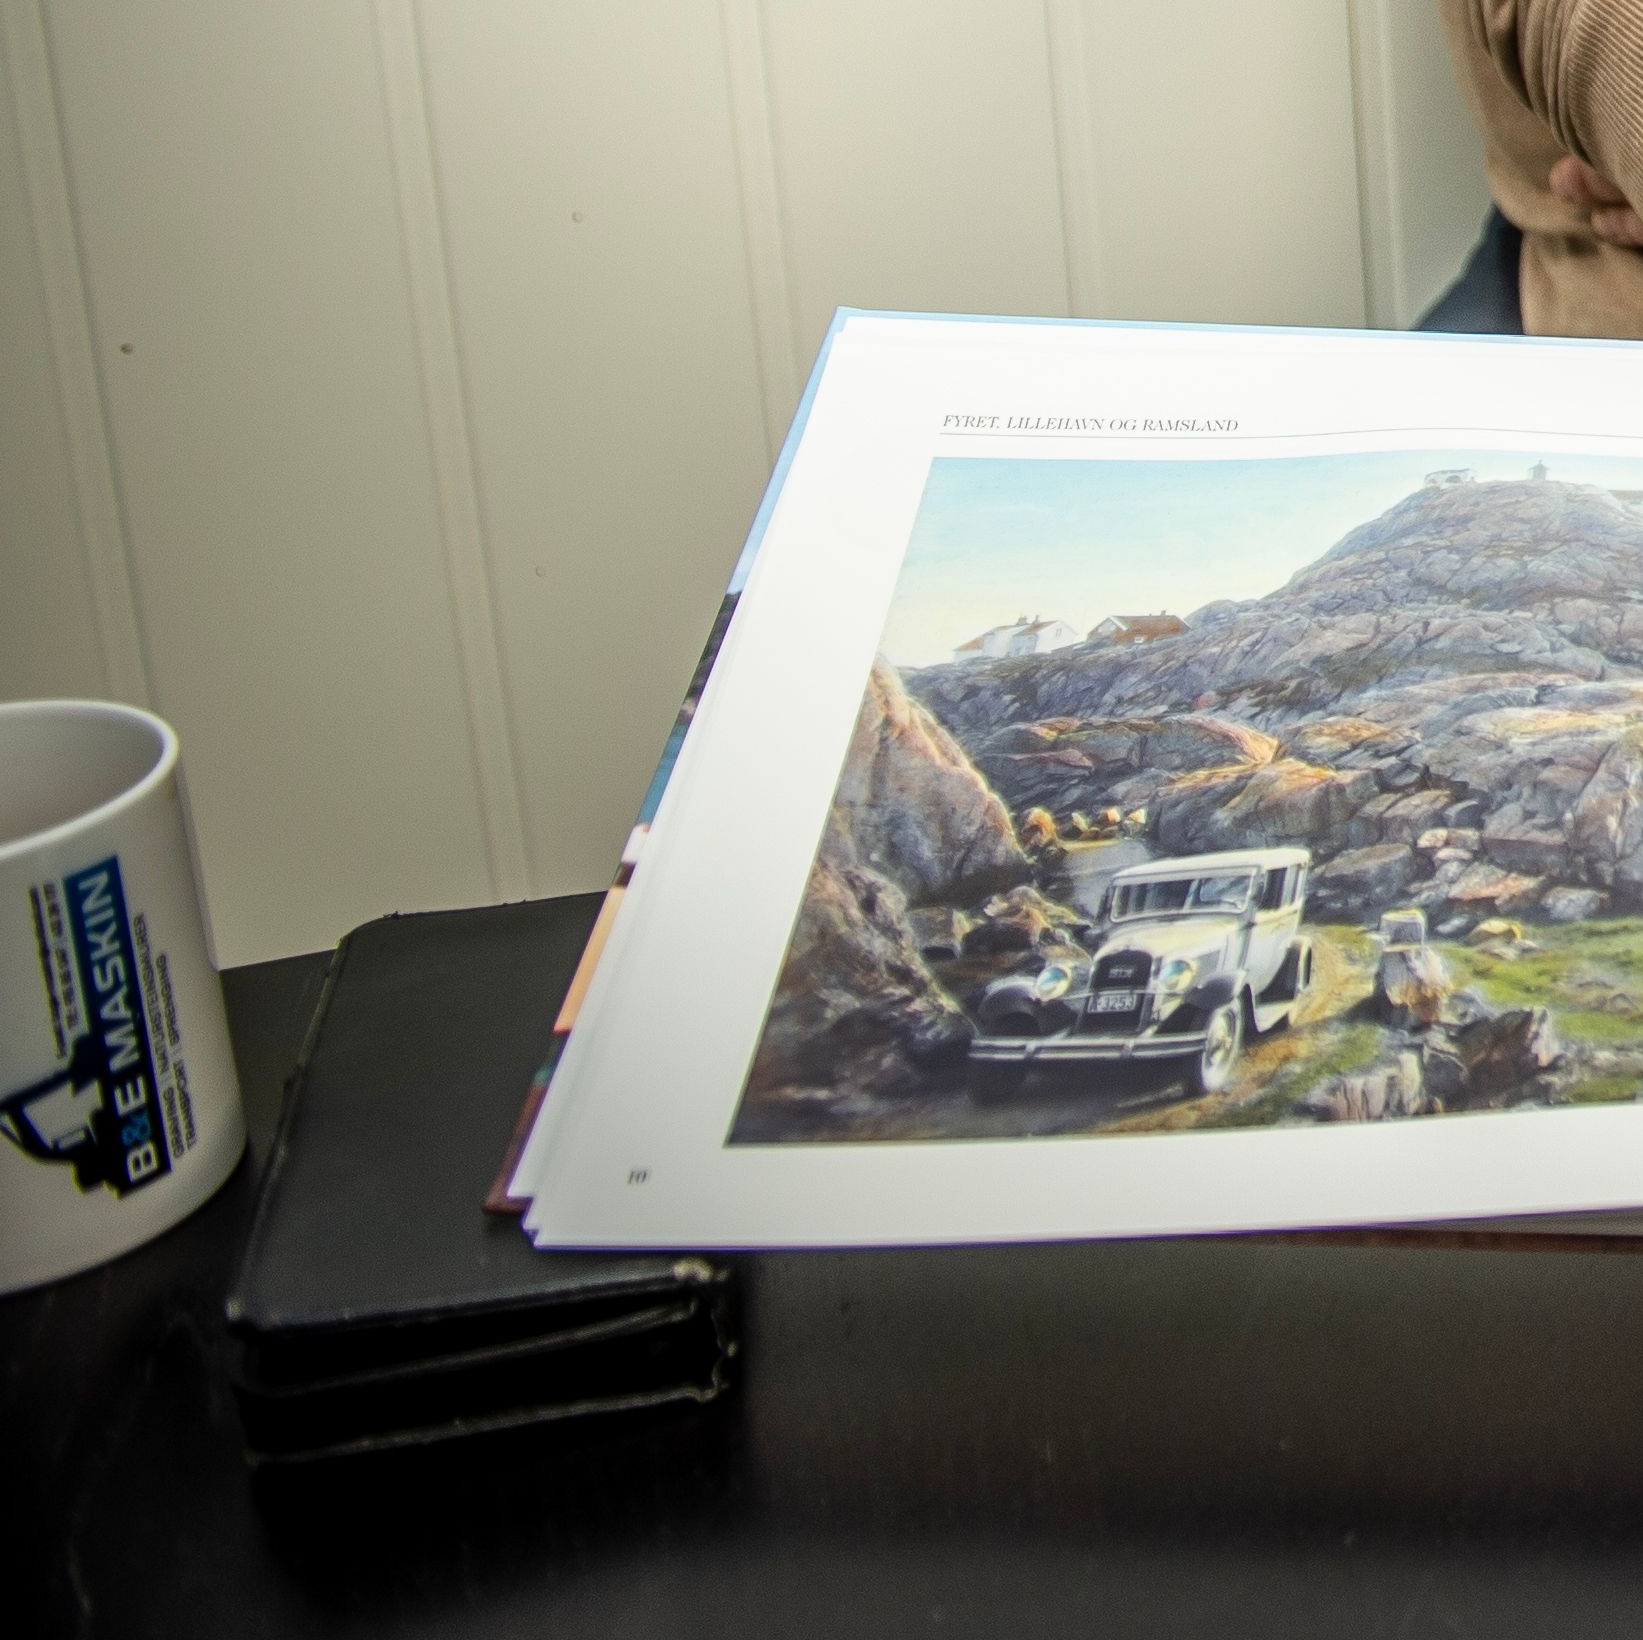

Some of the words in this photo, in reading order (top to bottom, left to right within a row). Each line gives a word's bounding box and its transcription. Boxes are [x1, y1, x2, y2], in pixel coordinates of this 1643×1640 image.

[1006, 416, 1105, 432] LILLEHAVN
[1109, 418, 1137, 432] OG
[1142, 418, 1239, 433] RAMSLAND
[78, 868, 141, 1074] MASKIN
[113, 1074, 159, 1184] B&E
